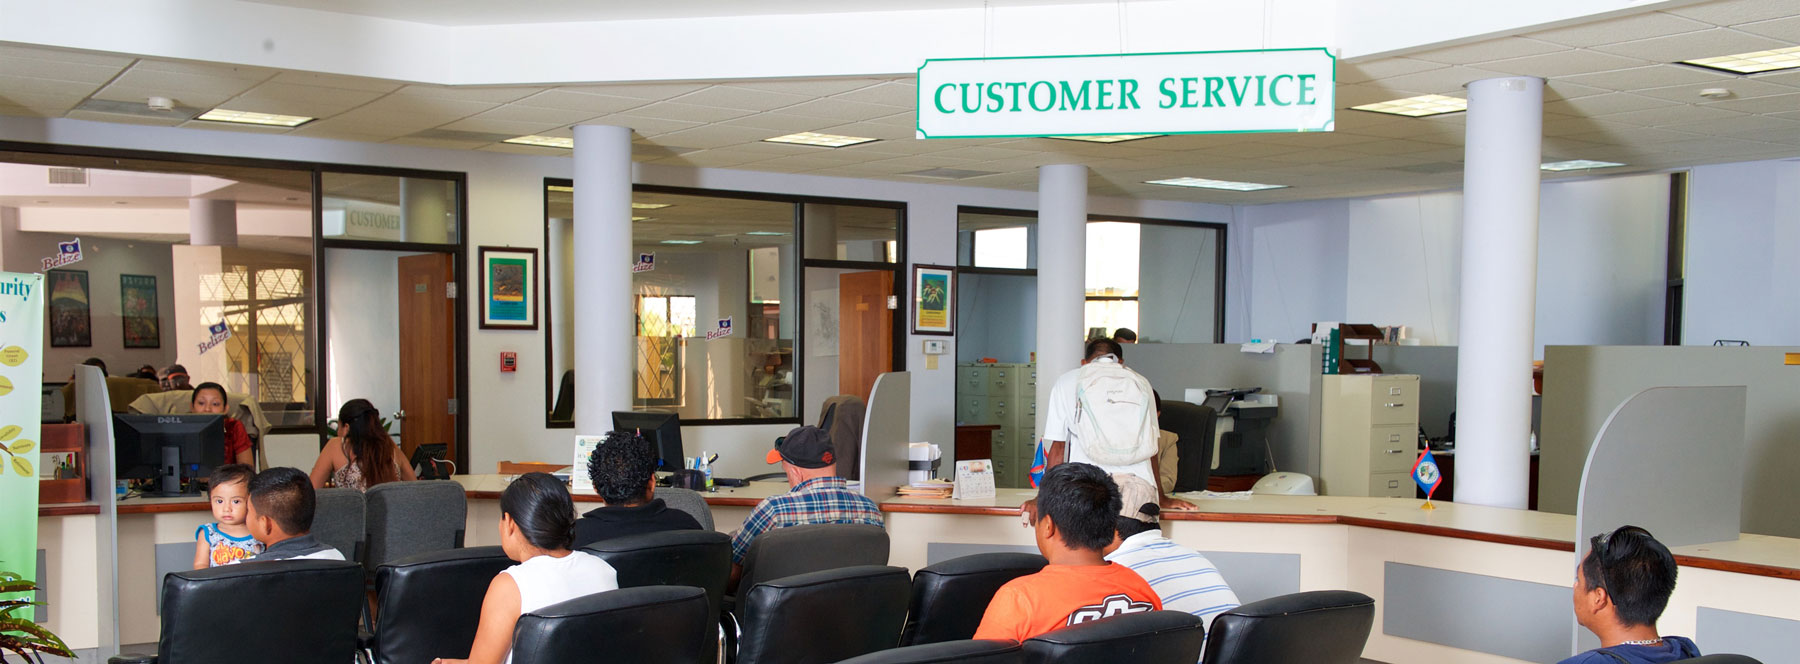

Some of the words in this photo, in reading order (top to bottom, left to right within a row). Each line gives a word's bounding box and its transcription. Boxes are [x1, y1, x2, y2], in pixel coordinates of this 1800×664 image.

[934, 79, 1141, 113] CUSTOMER
[1158, 74, 1316, 109] SERVICE
[42, 253, 81, 270] Belize
[632, 261, 653, 272] elize
[706, 327, 731, 341] Belize
[197, 330, 229, 355] Belize
[157, 416, 183, 424] DELL
